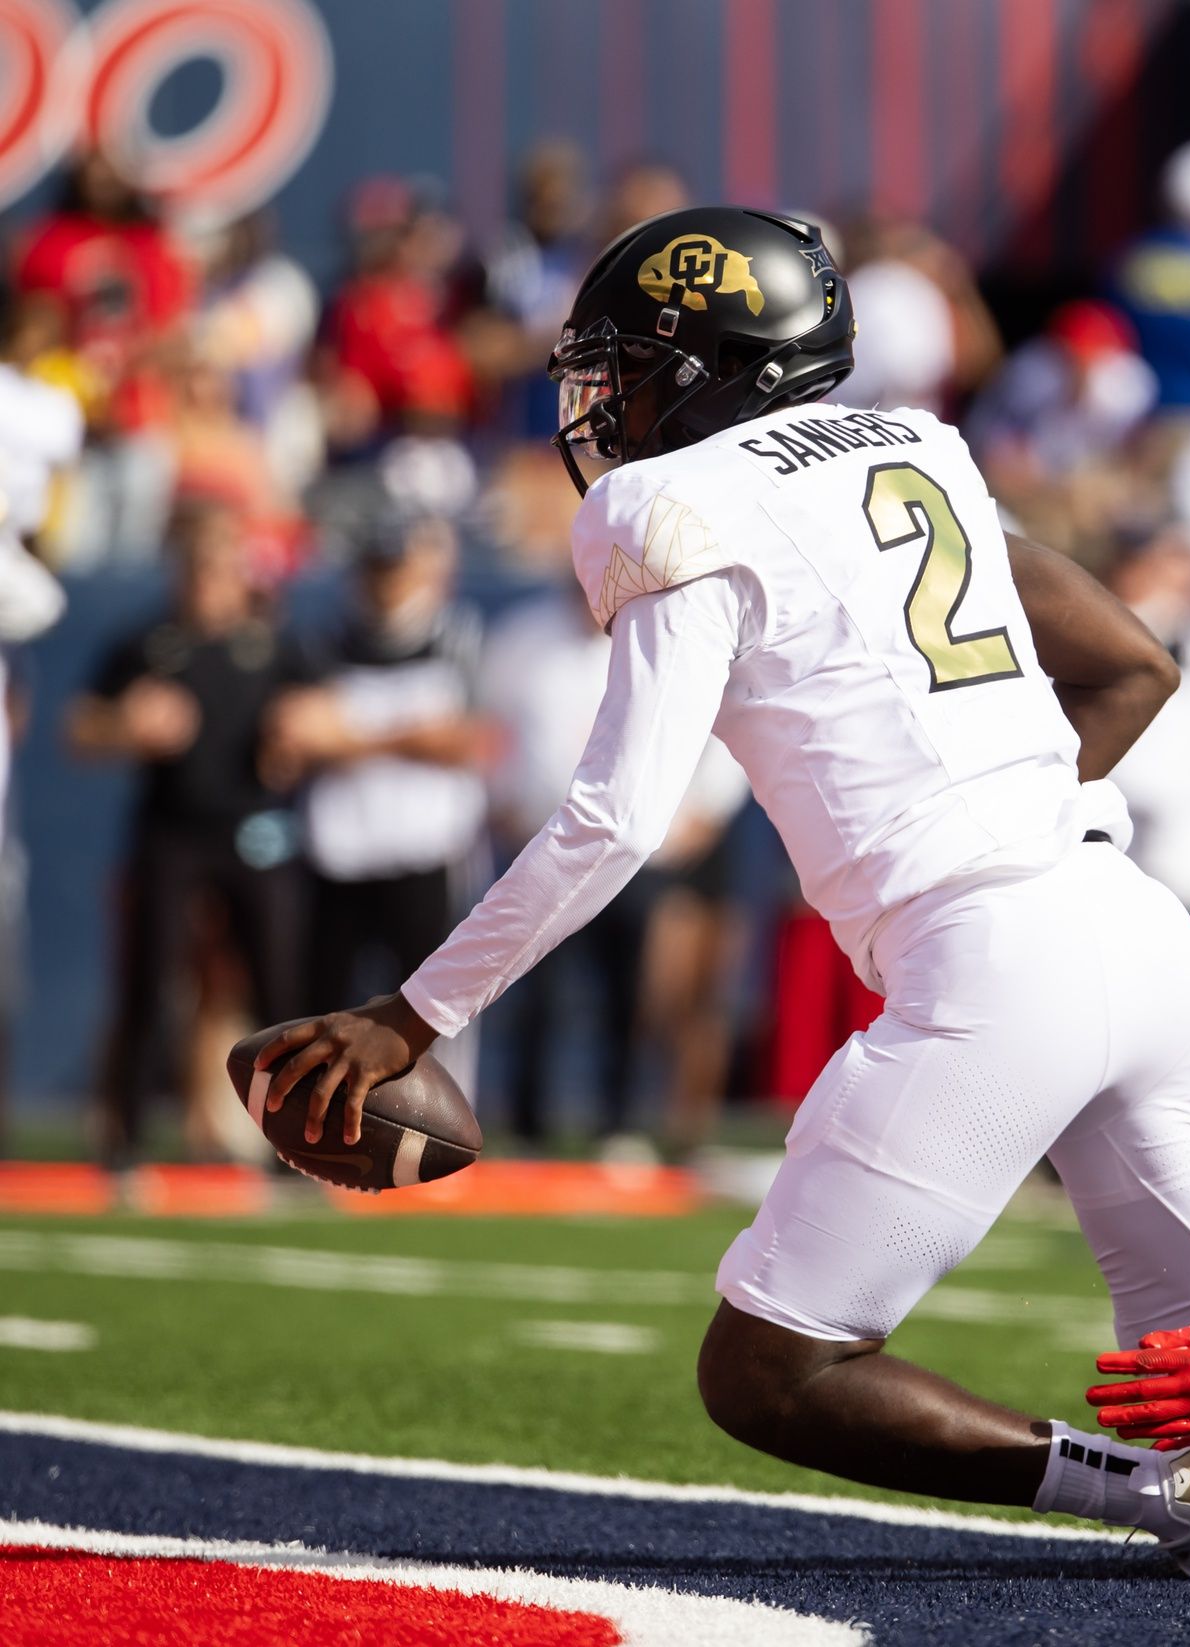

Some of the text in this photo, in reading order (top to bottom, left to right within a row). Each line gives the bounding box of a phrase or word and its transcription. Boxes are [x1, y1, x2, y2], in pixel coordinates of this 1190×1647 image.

[669, 240, 728, 293] CU
[738, 412, 922, 475] SANDERS
[862, 461, 1025, 694] 2
